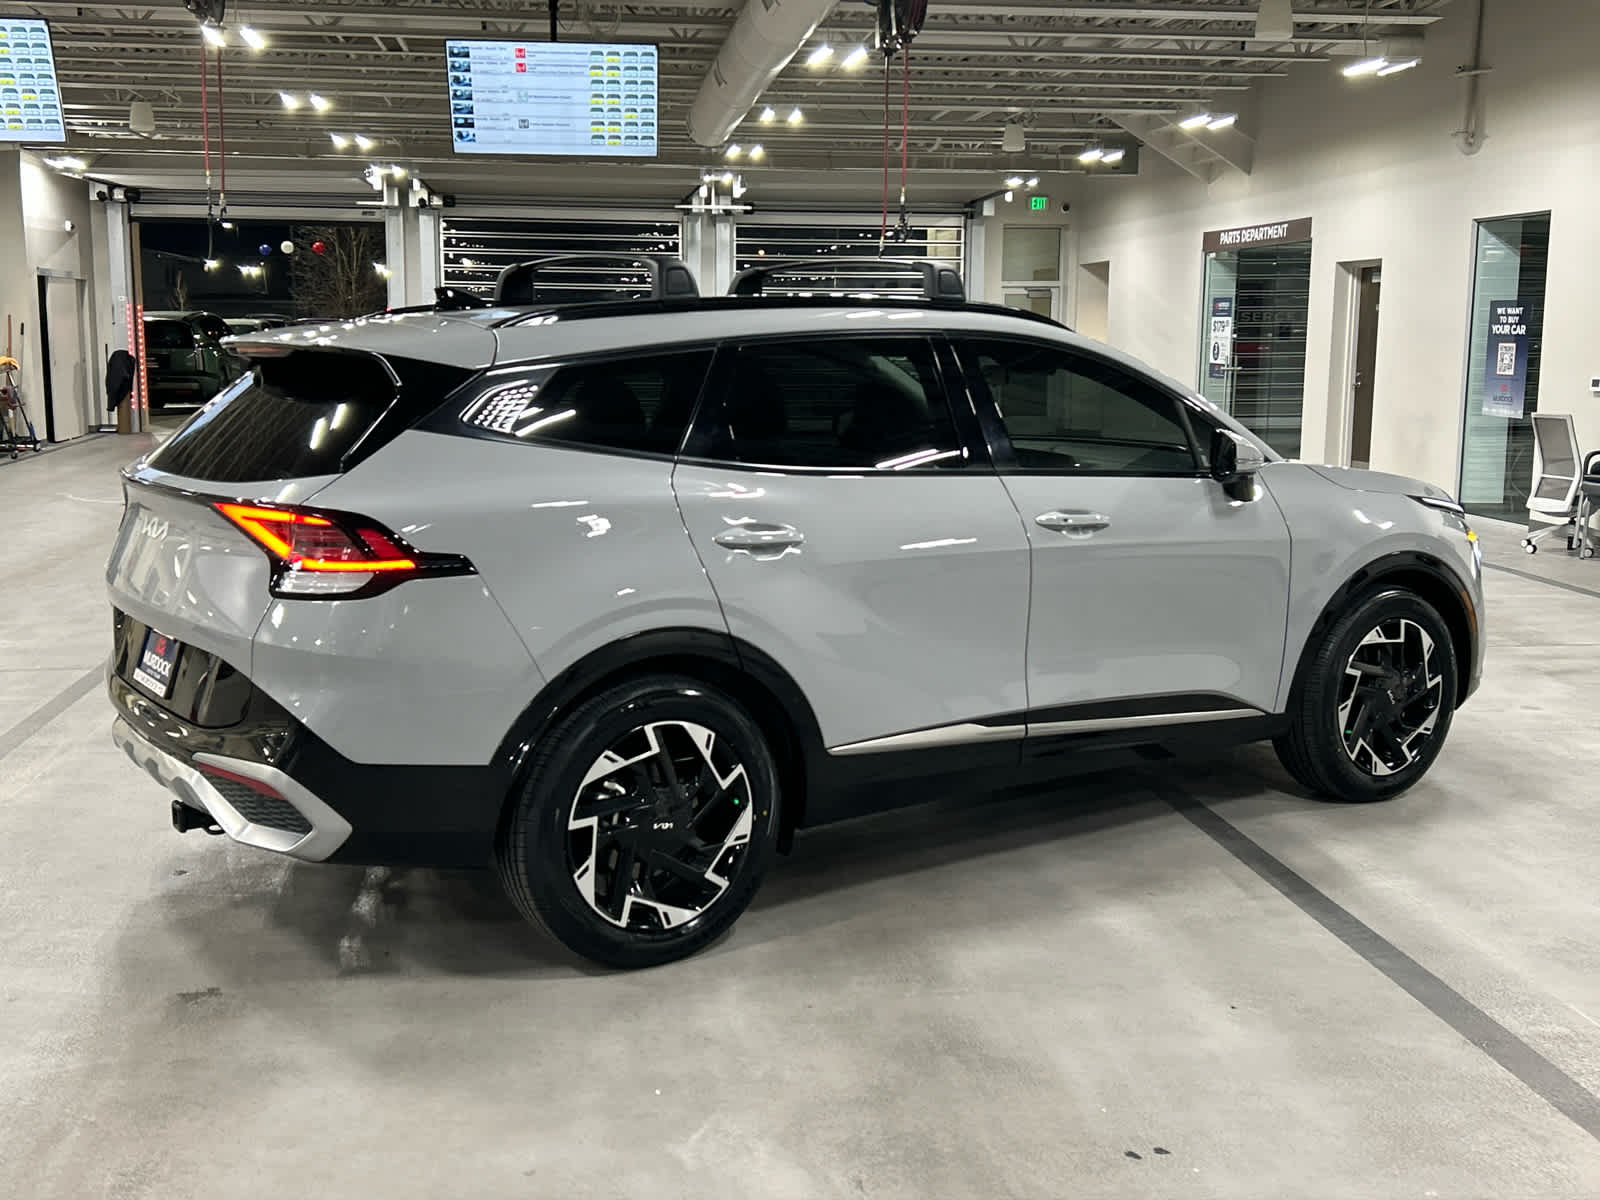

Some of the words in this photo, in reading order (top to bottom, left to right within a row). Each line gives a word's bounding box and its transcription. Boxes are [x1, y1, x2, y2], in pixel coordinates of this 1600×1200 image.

[1031, 196, 1047, 210] EXIT
[1219, 230, 1241, 245] PARTS
[1241, 223, 1288, 243] DEPARTMENT
[1496, 307, 1506, 315] WE
[1507, 307, 1524, 315] WANT
[1499, 316, 1507, 324] TO
[1508, 316, 1519, 324] BUY
[1491, 325, 1510, 335] YOUR
[1511, 324, 1527, 335] CAR
